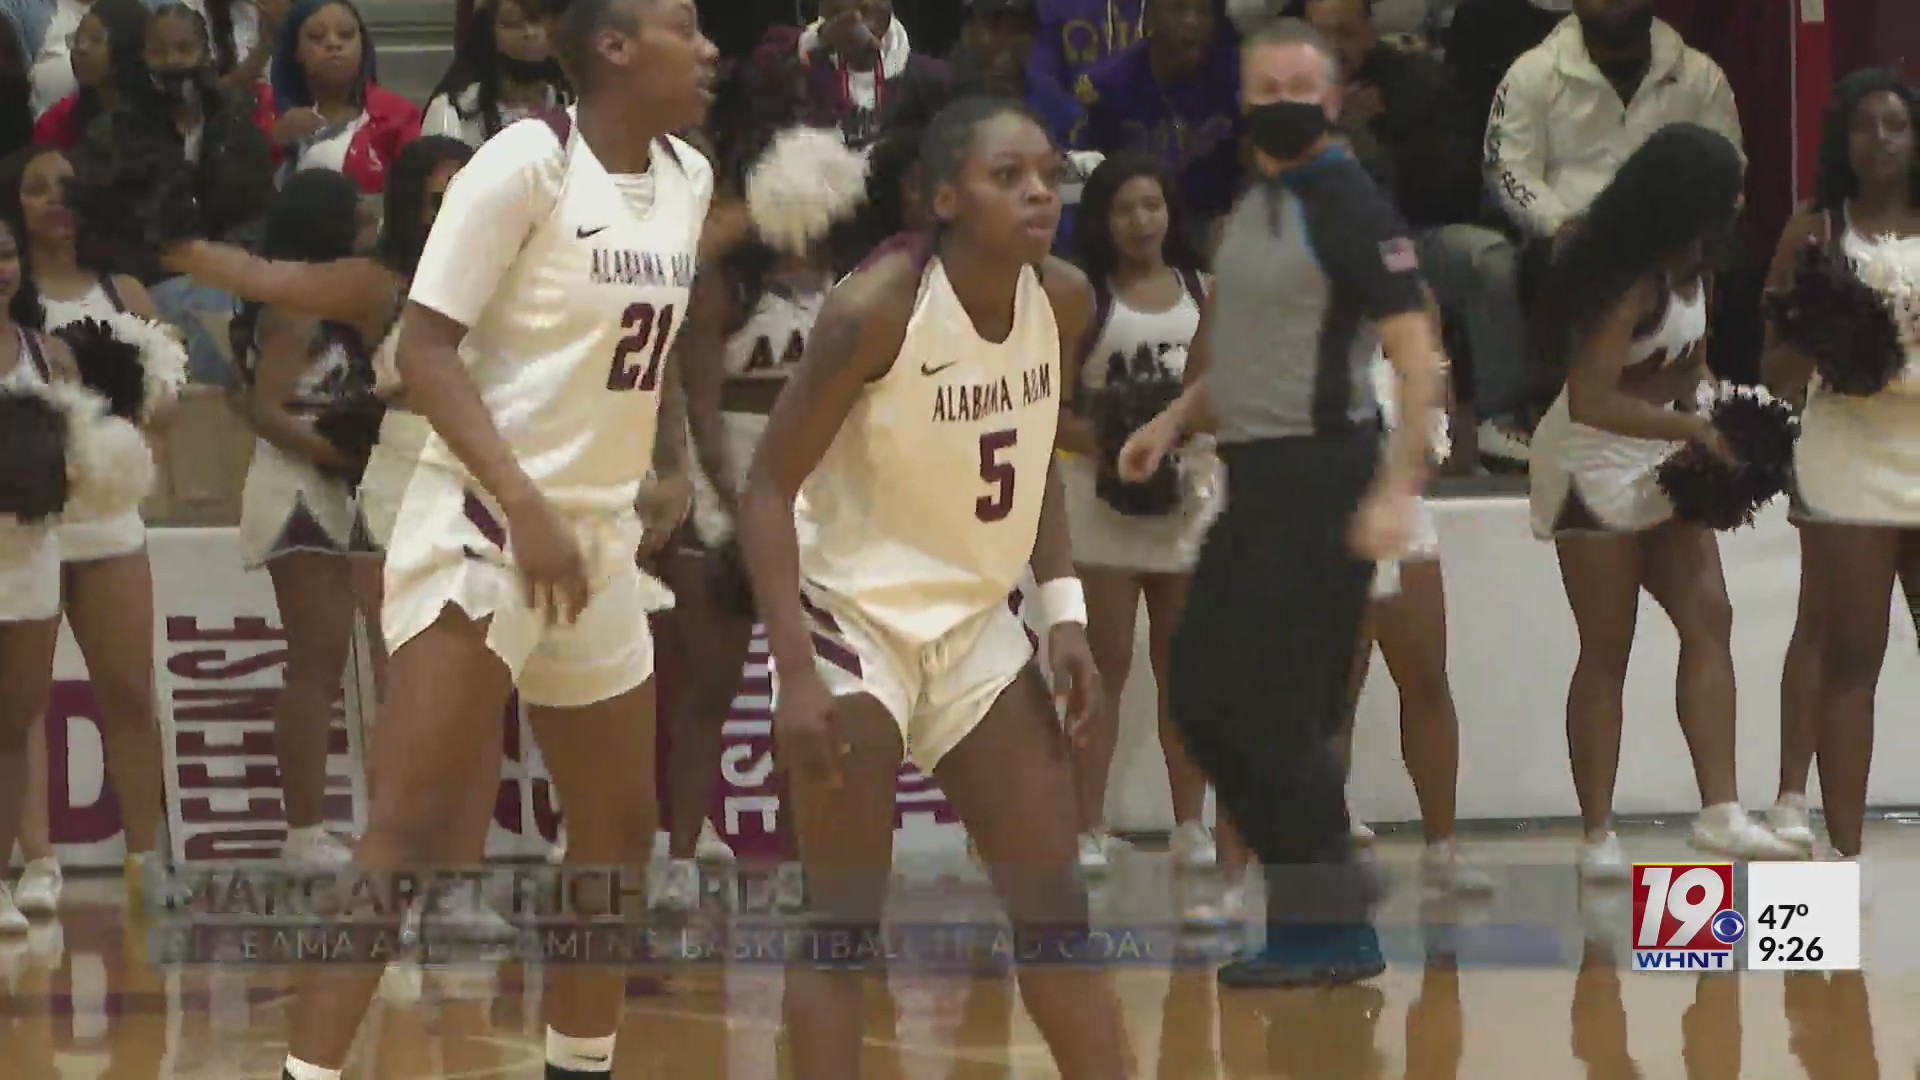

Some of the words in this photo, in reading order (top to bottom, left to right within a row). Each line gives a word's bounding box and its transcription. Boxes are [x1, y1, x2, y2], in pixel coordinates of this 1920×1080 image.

[606, 302, 674, 391] 21
[932, 376, 1013, 422] ALABAMA
[1022, 363, 1051, 407] A&M
[975, 428, 1018, 523] 5
